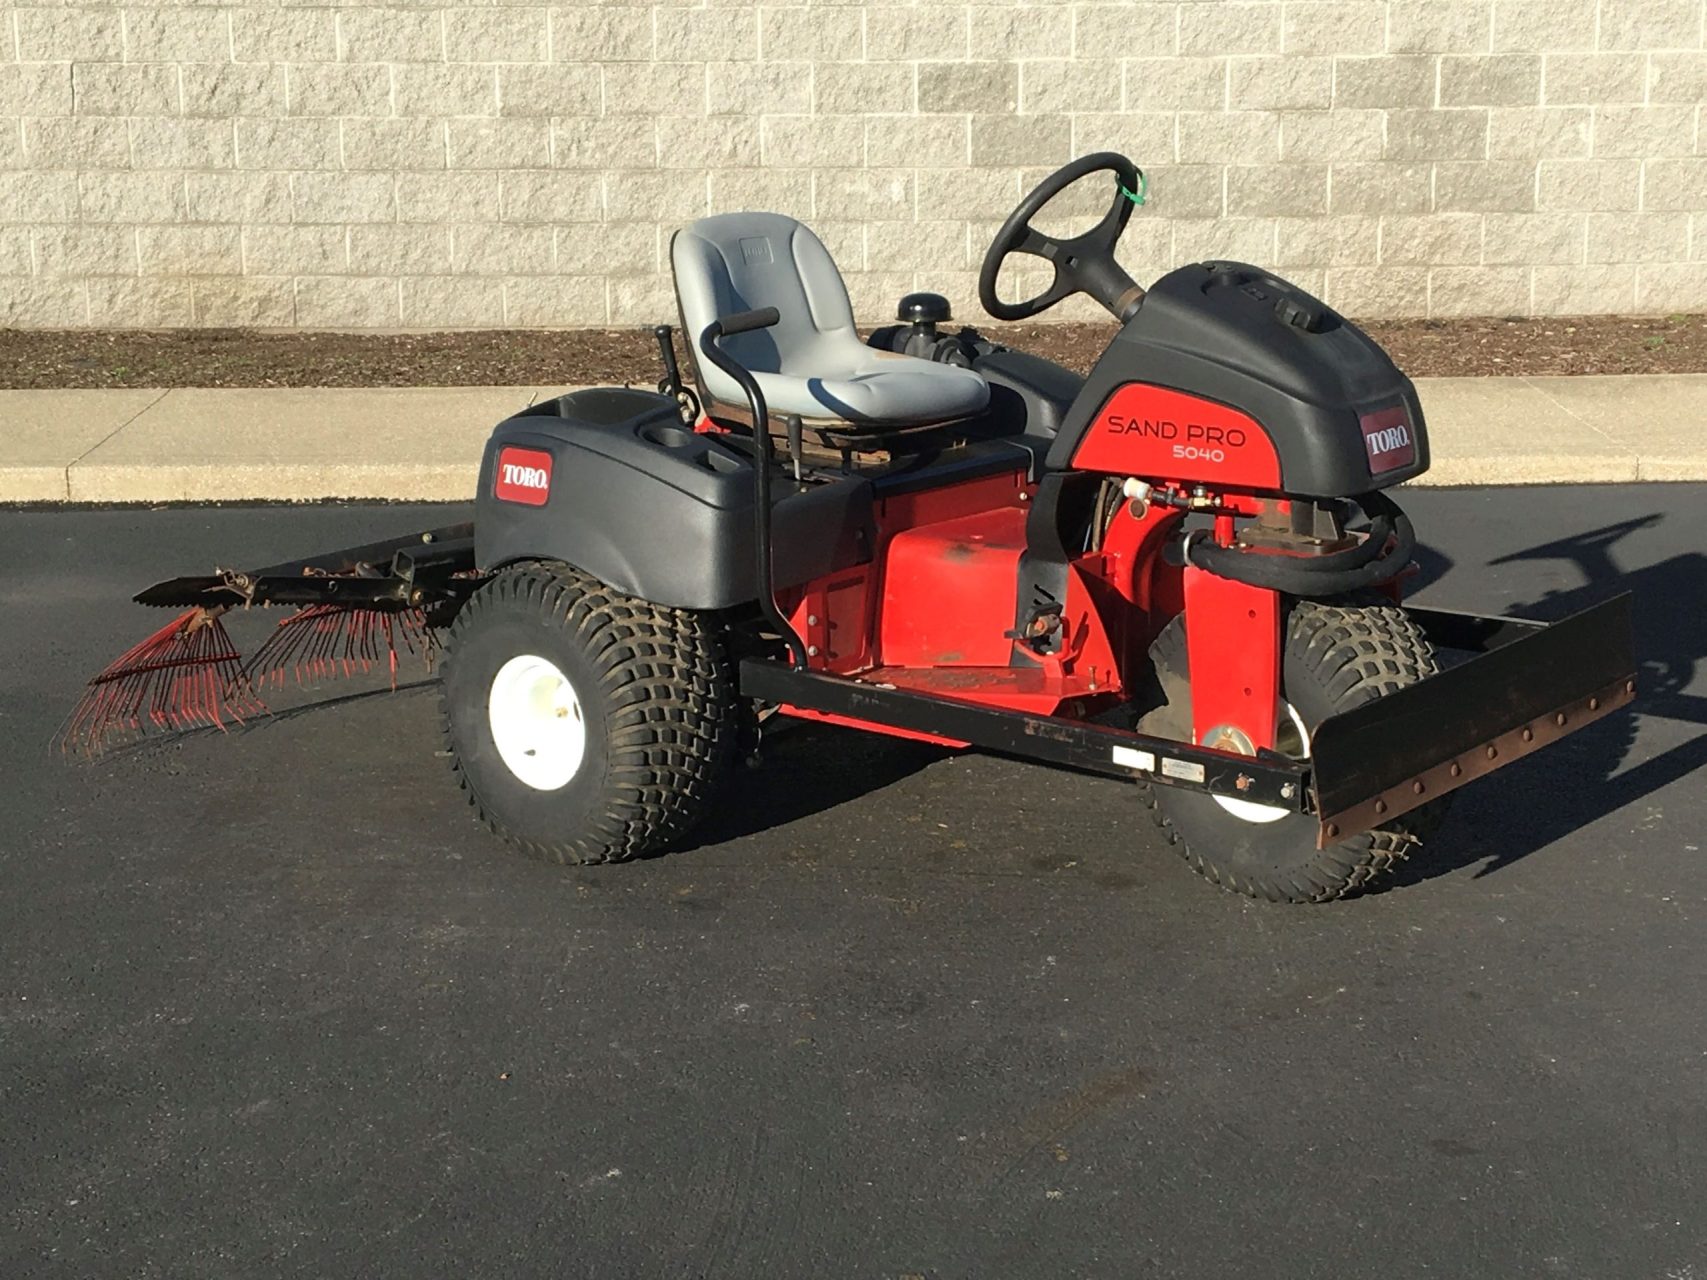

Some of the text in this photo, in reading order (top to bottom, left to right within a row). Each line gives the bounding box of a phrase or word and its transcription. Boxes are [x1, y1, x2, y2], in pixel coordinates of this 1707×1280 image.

[1108, 416, 1246, 447] SAND PRO
[1173, 445, 1225, 462] 5040
